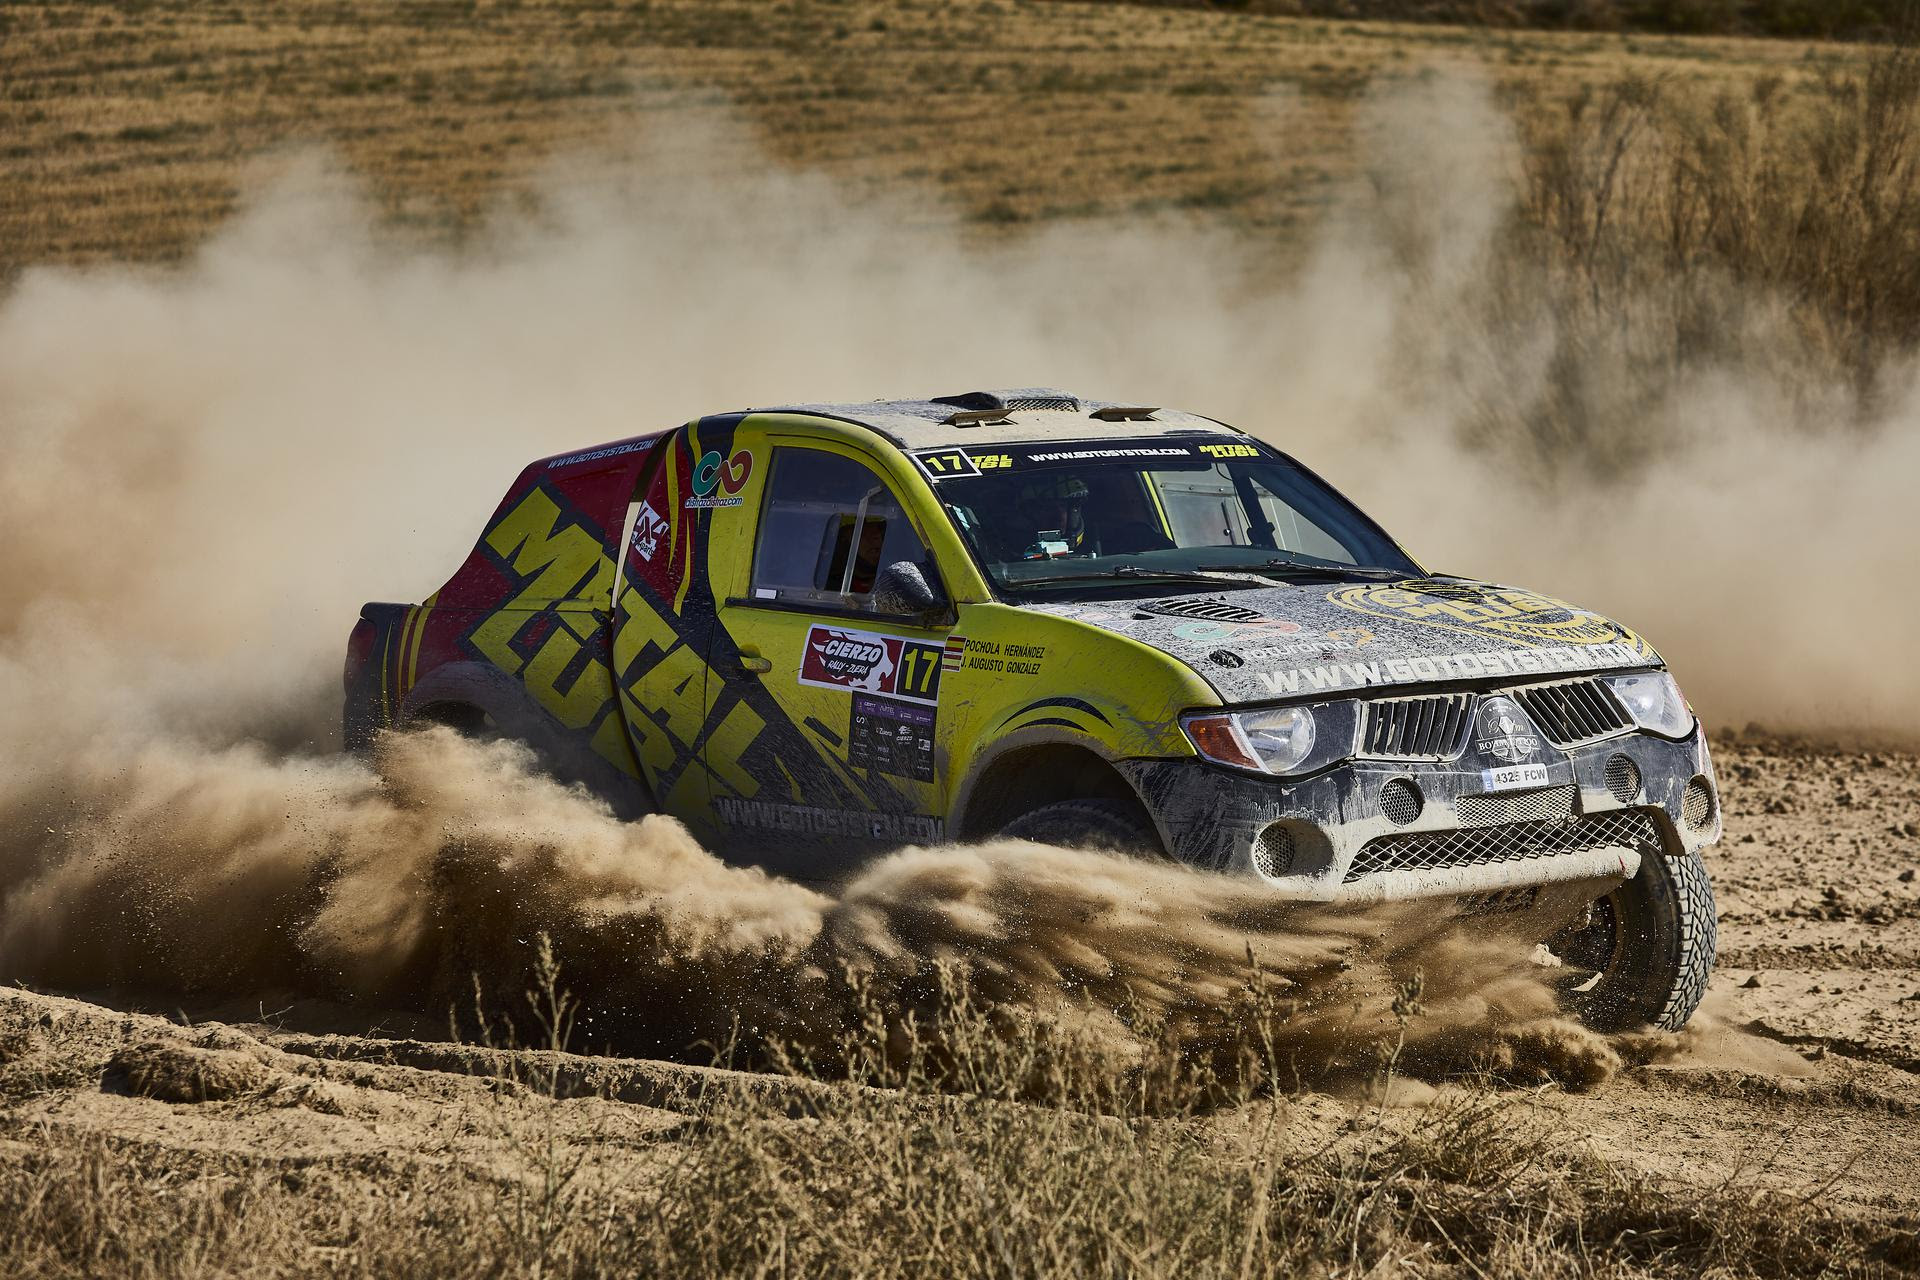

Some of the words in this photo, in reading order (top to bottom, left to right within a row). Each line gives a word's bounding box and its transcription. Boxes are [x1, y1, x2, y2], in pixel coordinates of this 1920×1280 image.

[548, 439, 656, 469] WWW.GOTOSYSTEM.COM
[969, 454, 1013, 463] TAL
[1028, 448, 1190, 462] WWW.GOTOSYSTEM.COM
[925, 455, 962, 472] 17
[825, 640, 882, 663] CIERZO
[964, 639, 1000, 655] POCHOLA
[1004, 643, 1045, 659] HERNÁNDEZ
[828, 660, 846, 672] RALLY
[847, 663, 869, 675] ZUERA
[904, 648, 941, 693] 17
[968, 656, 1004, 672] AUGUSTO
[1006, 660, 1041, 675] GONZÁLEZ
[1495, 769, 1521, 784] 4325
[1525, 768, 1547, 781] FCW
